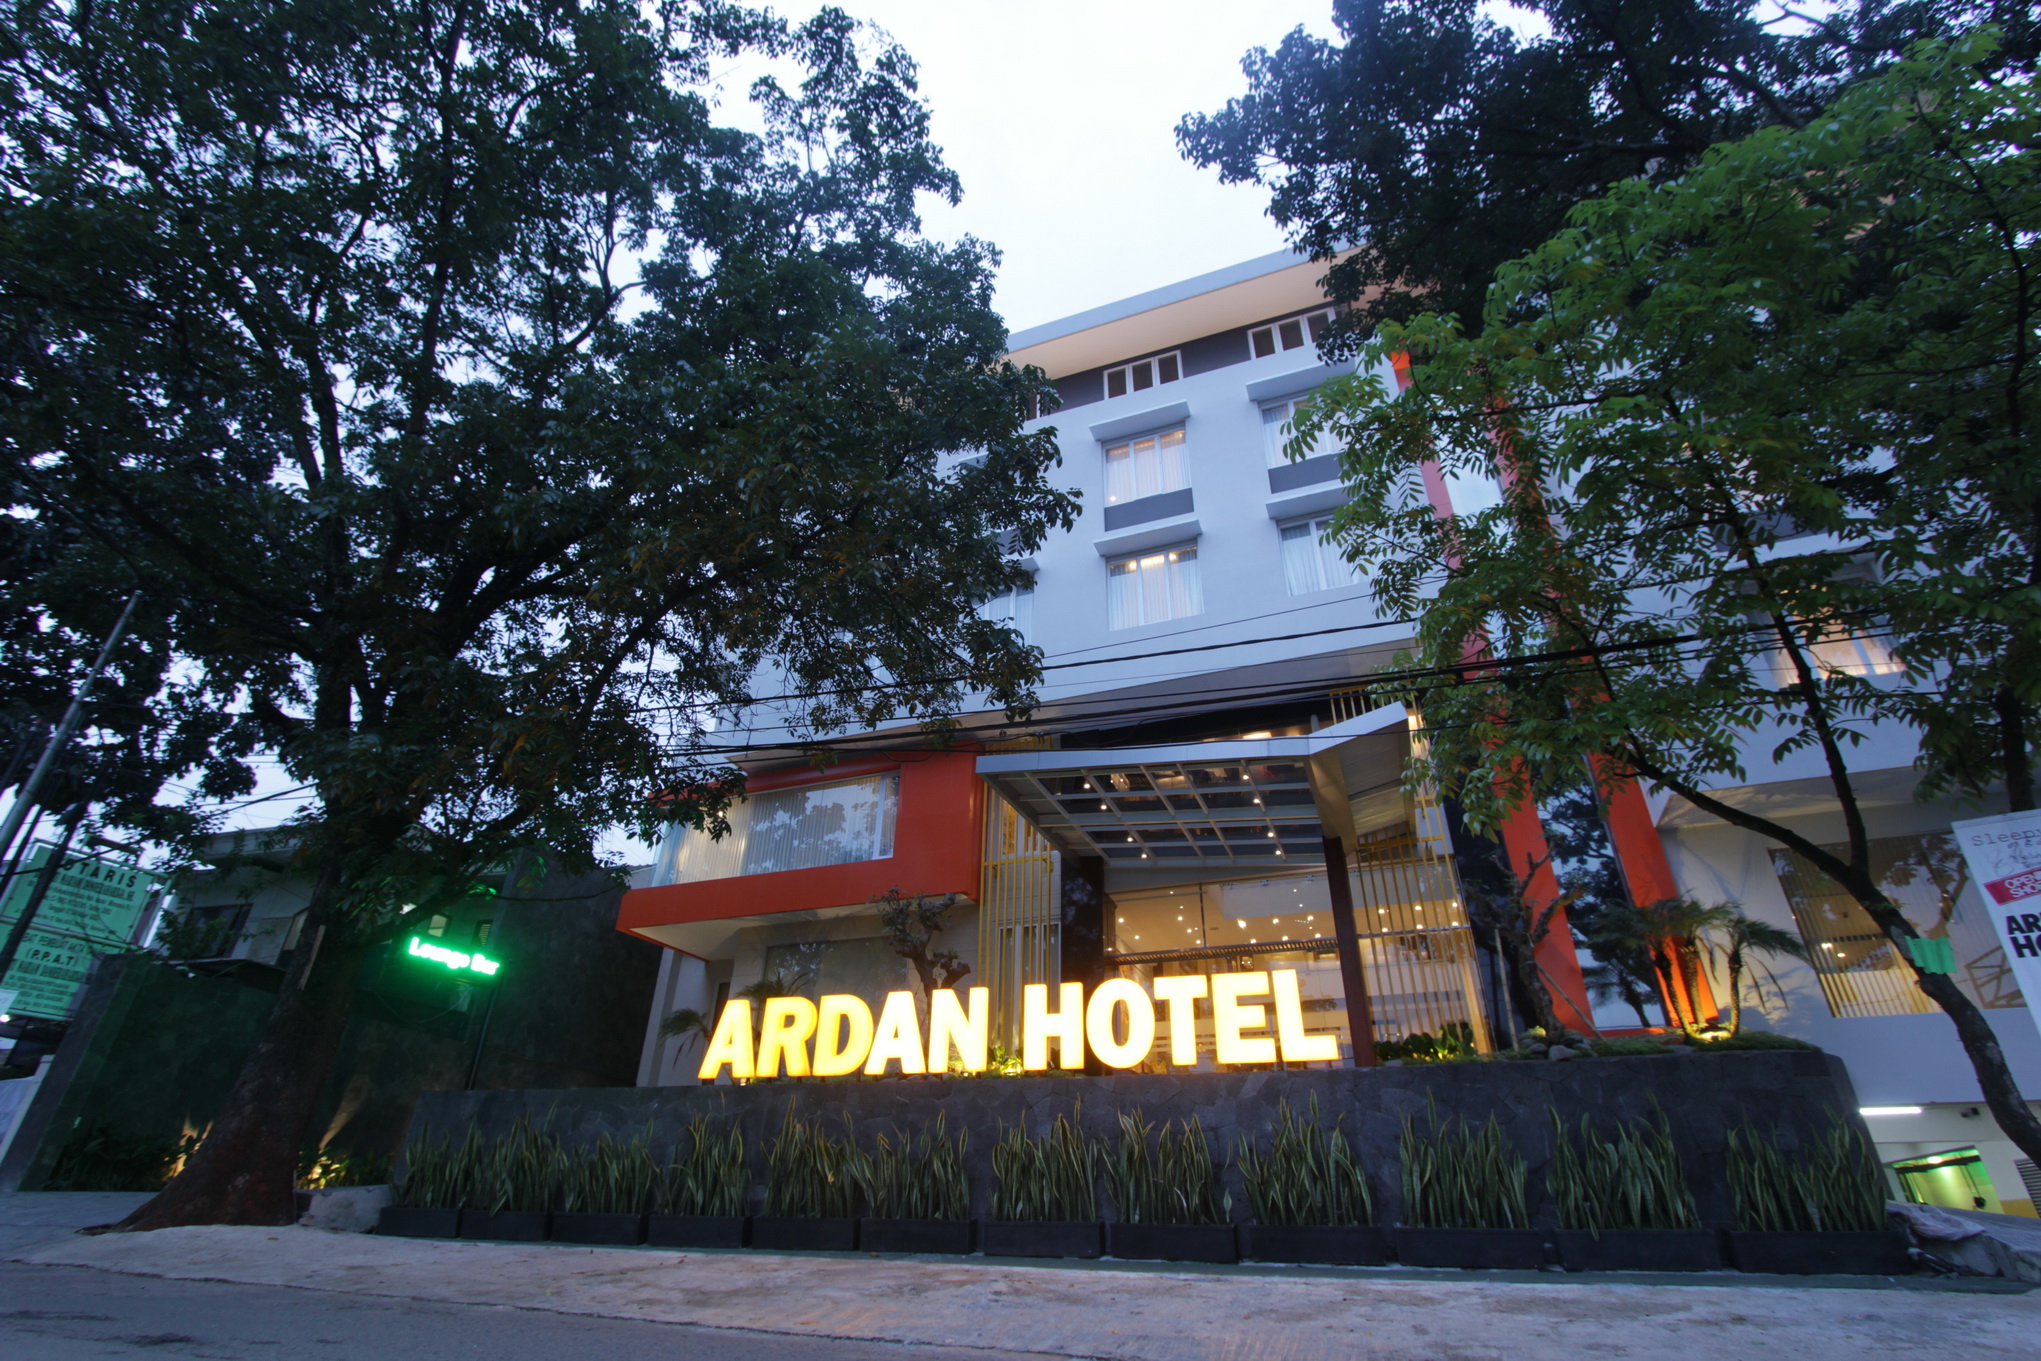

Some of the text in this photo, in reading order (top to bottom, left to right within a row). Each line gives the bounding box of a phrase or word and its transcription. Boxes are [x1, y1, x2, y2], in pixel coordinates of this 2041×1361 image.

[61, 857, 138, 889] OTARIS
[2006, 911, 2041, 936] AR
[2009, 932, 2041, 958] H
[698, 969, 1340, 1080] ARDAN HOTEL
